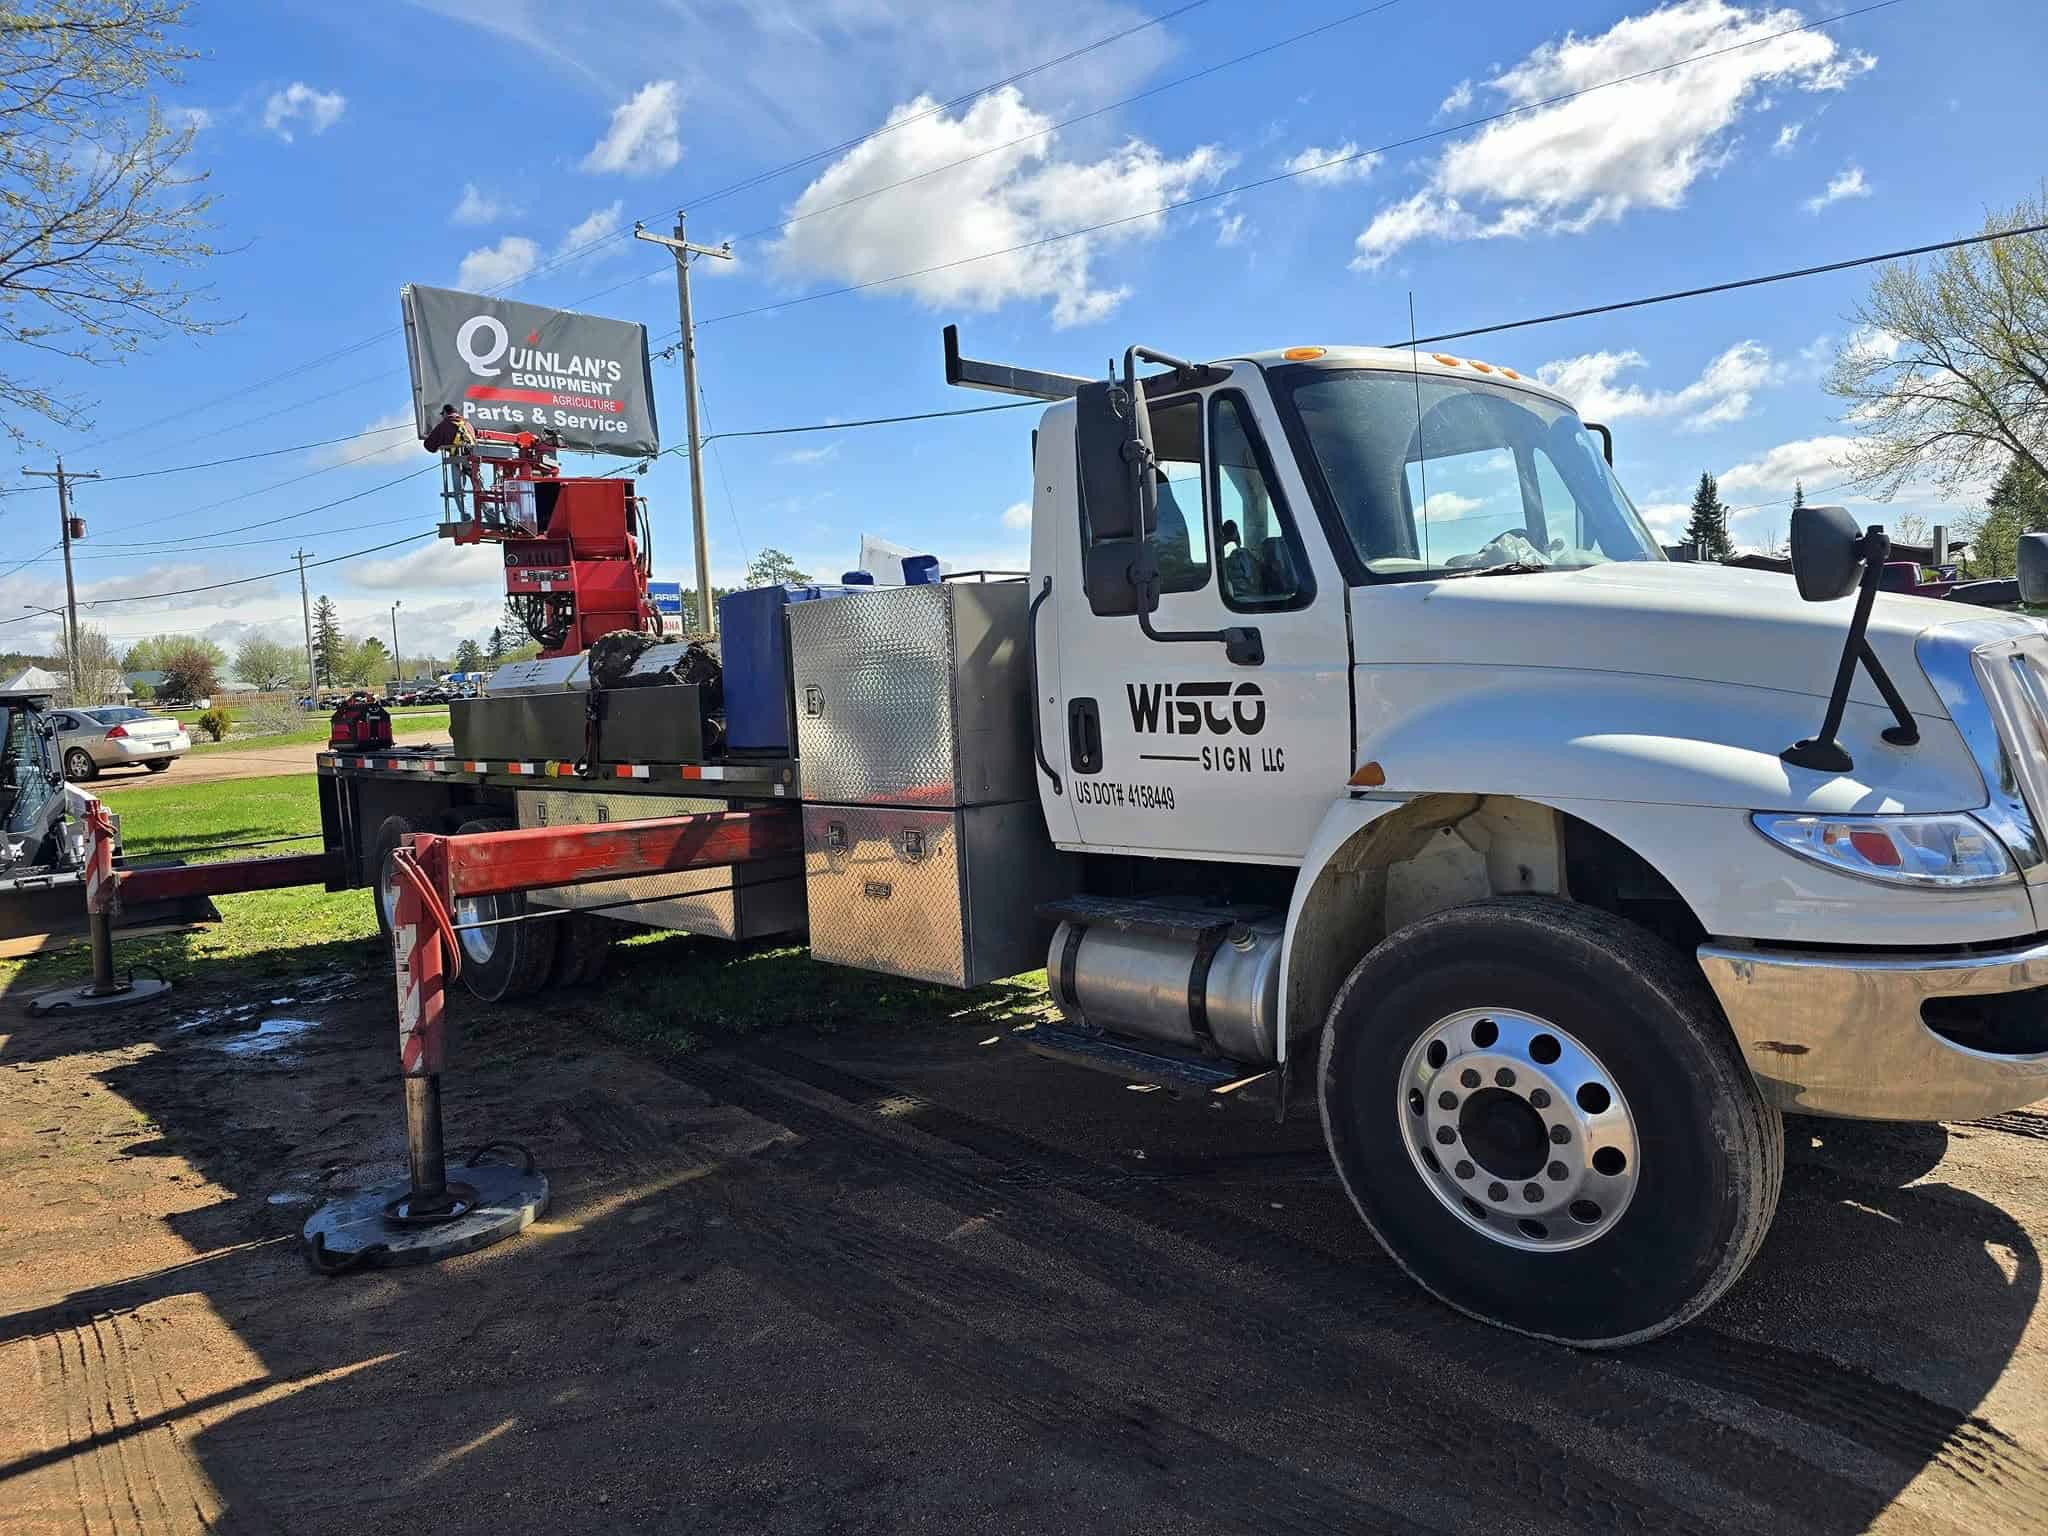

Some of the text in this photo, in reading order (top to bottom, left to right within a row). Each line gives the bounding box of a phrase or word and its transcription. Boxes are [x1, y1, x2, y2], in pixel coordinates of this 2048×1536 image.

[457, 315, 621, 381] QUINLAN'S
[512, 372, 612, 396] EQUIPMENT
[463, 401, 628, 433] Parts & Service
[552, 395, 616, 412] AGRICULTURE
[1126, 681, 1266, 735] WISCO
[1202, 746, 1285, 772] SIGN LLC
[1075, 781, 1175, 810] US DOT# 4158449
